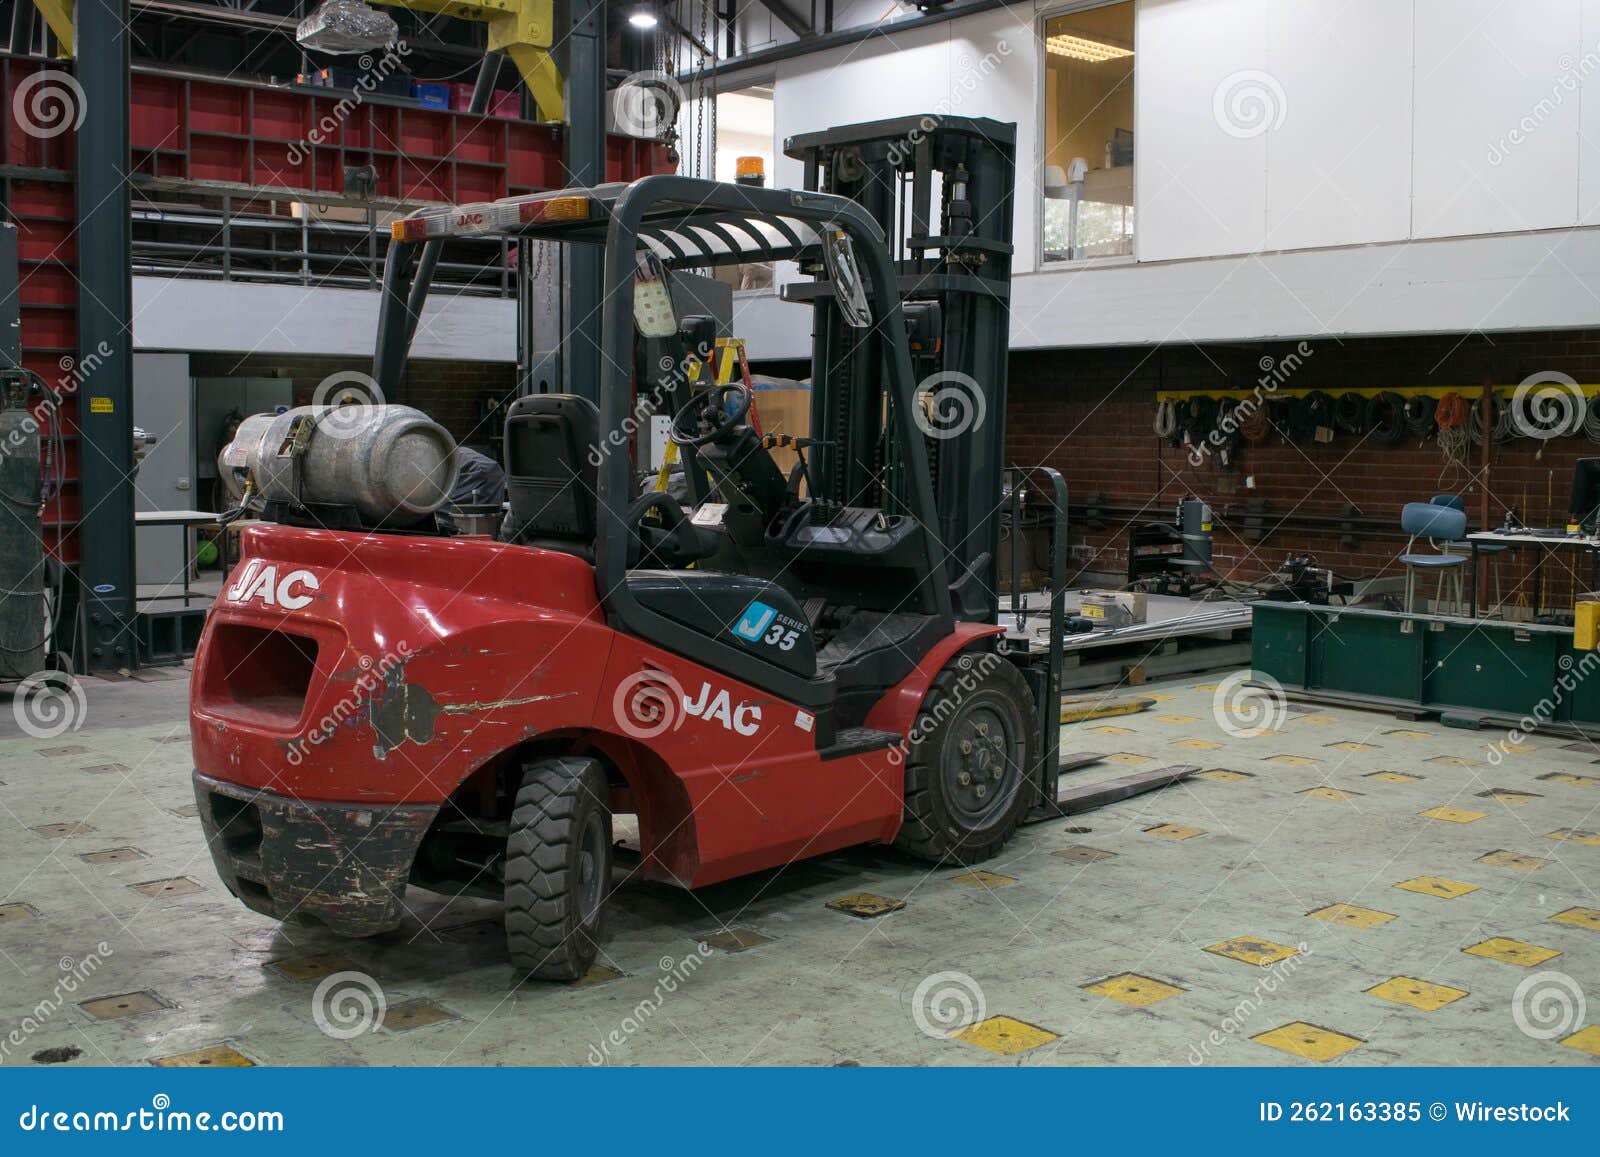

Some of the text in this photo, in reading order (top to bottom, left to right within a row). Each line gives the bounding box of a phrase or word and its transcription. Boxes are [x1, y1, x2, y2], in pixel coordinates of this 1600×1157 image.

[457, 213, 482, 226] JAC
[227, 562, 320, 610] JAC
[776, 613, 809, 633] SERIES
[765, 624, 800, 651] 35
[682, 681, 762, 737] JAC
